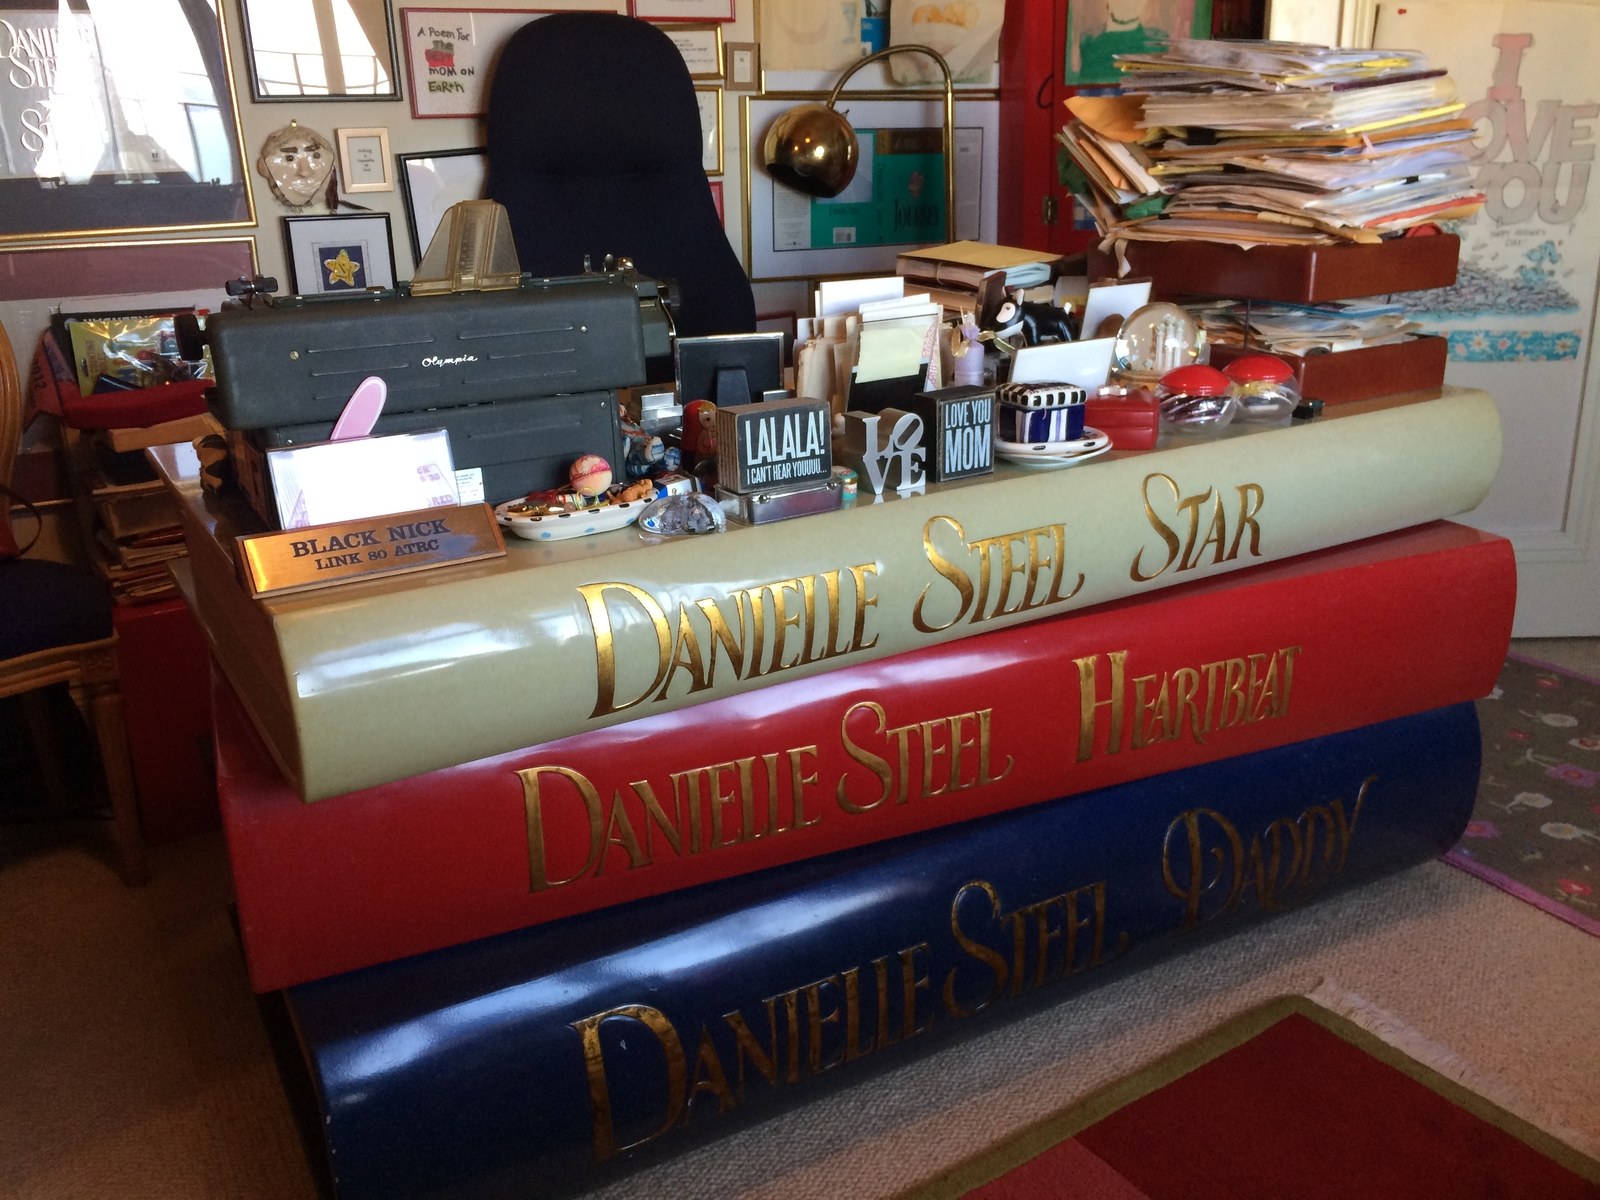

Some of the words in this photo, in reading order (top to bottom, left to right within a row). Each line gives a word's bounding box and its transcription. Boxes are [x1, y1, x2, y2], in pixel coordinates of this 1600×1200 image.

[417, 27, 426, 37] A
[428, 27, 455, 39] Poem
[1485, 33, 1533, 101] I
[421, 354, 478, 367] Olympia
[945, 402, 970, 429] LOVE
[971, 398, 991, 423] YOU
[745, 410, 825, 466] LALALA!
[945, 424, 991, 473] MOM
[746, 468, 750, 485] I
[751, 465, 772, 484] CAN'T
[772, 462, 792, 480] HEAR
[290, 529, 381, 557] BLACK
[386, 518, 451, 541] NICK
[315, 552, 363, 570] LINK
[394, 539, 440, 557] ATRC
[576, 562, 880, 719] DANIELLE
[912, 515, 1085, 633] STEEL
[1130, 473, 1264, 582] STAR
[514, 745, 823, 893] DANIELLE
[836, 701, 1015, 816] STEEL
[1072, 645, 1302, 764] HEARTBEAT
[568, 943, 937, 1160] DANIELLE
[943, 880, 1130, 1019] STEEL
[1162, 775, 1378, 930] DADDY
